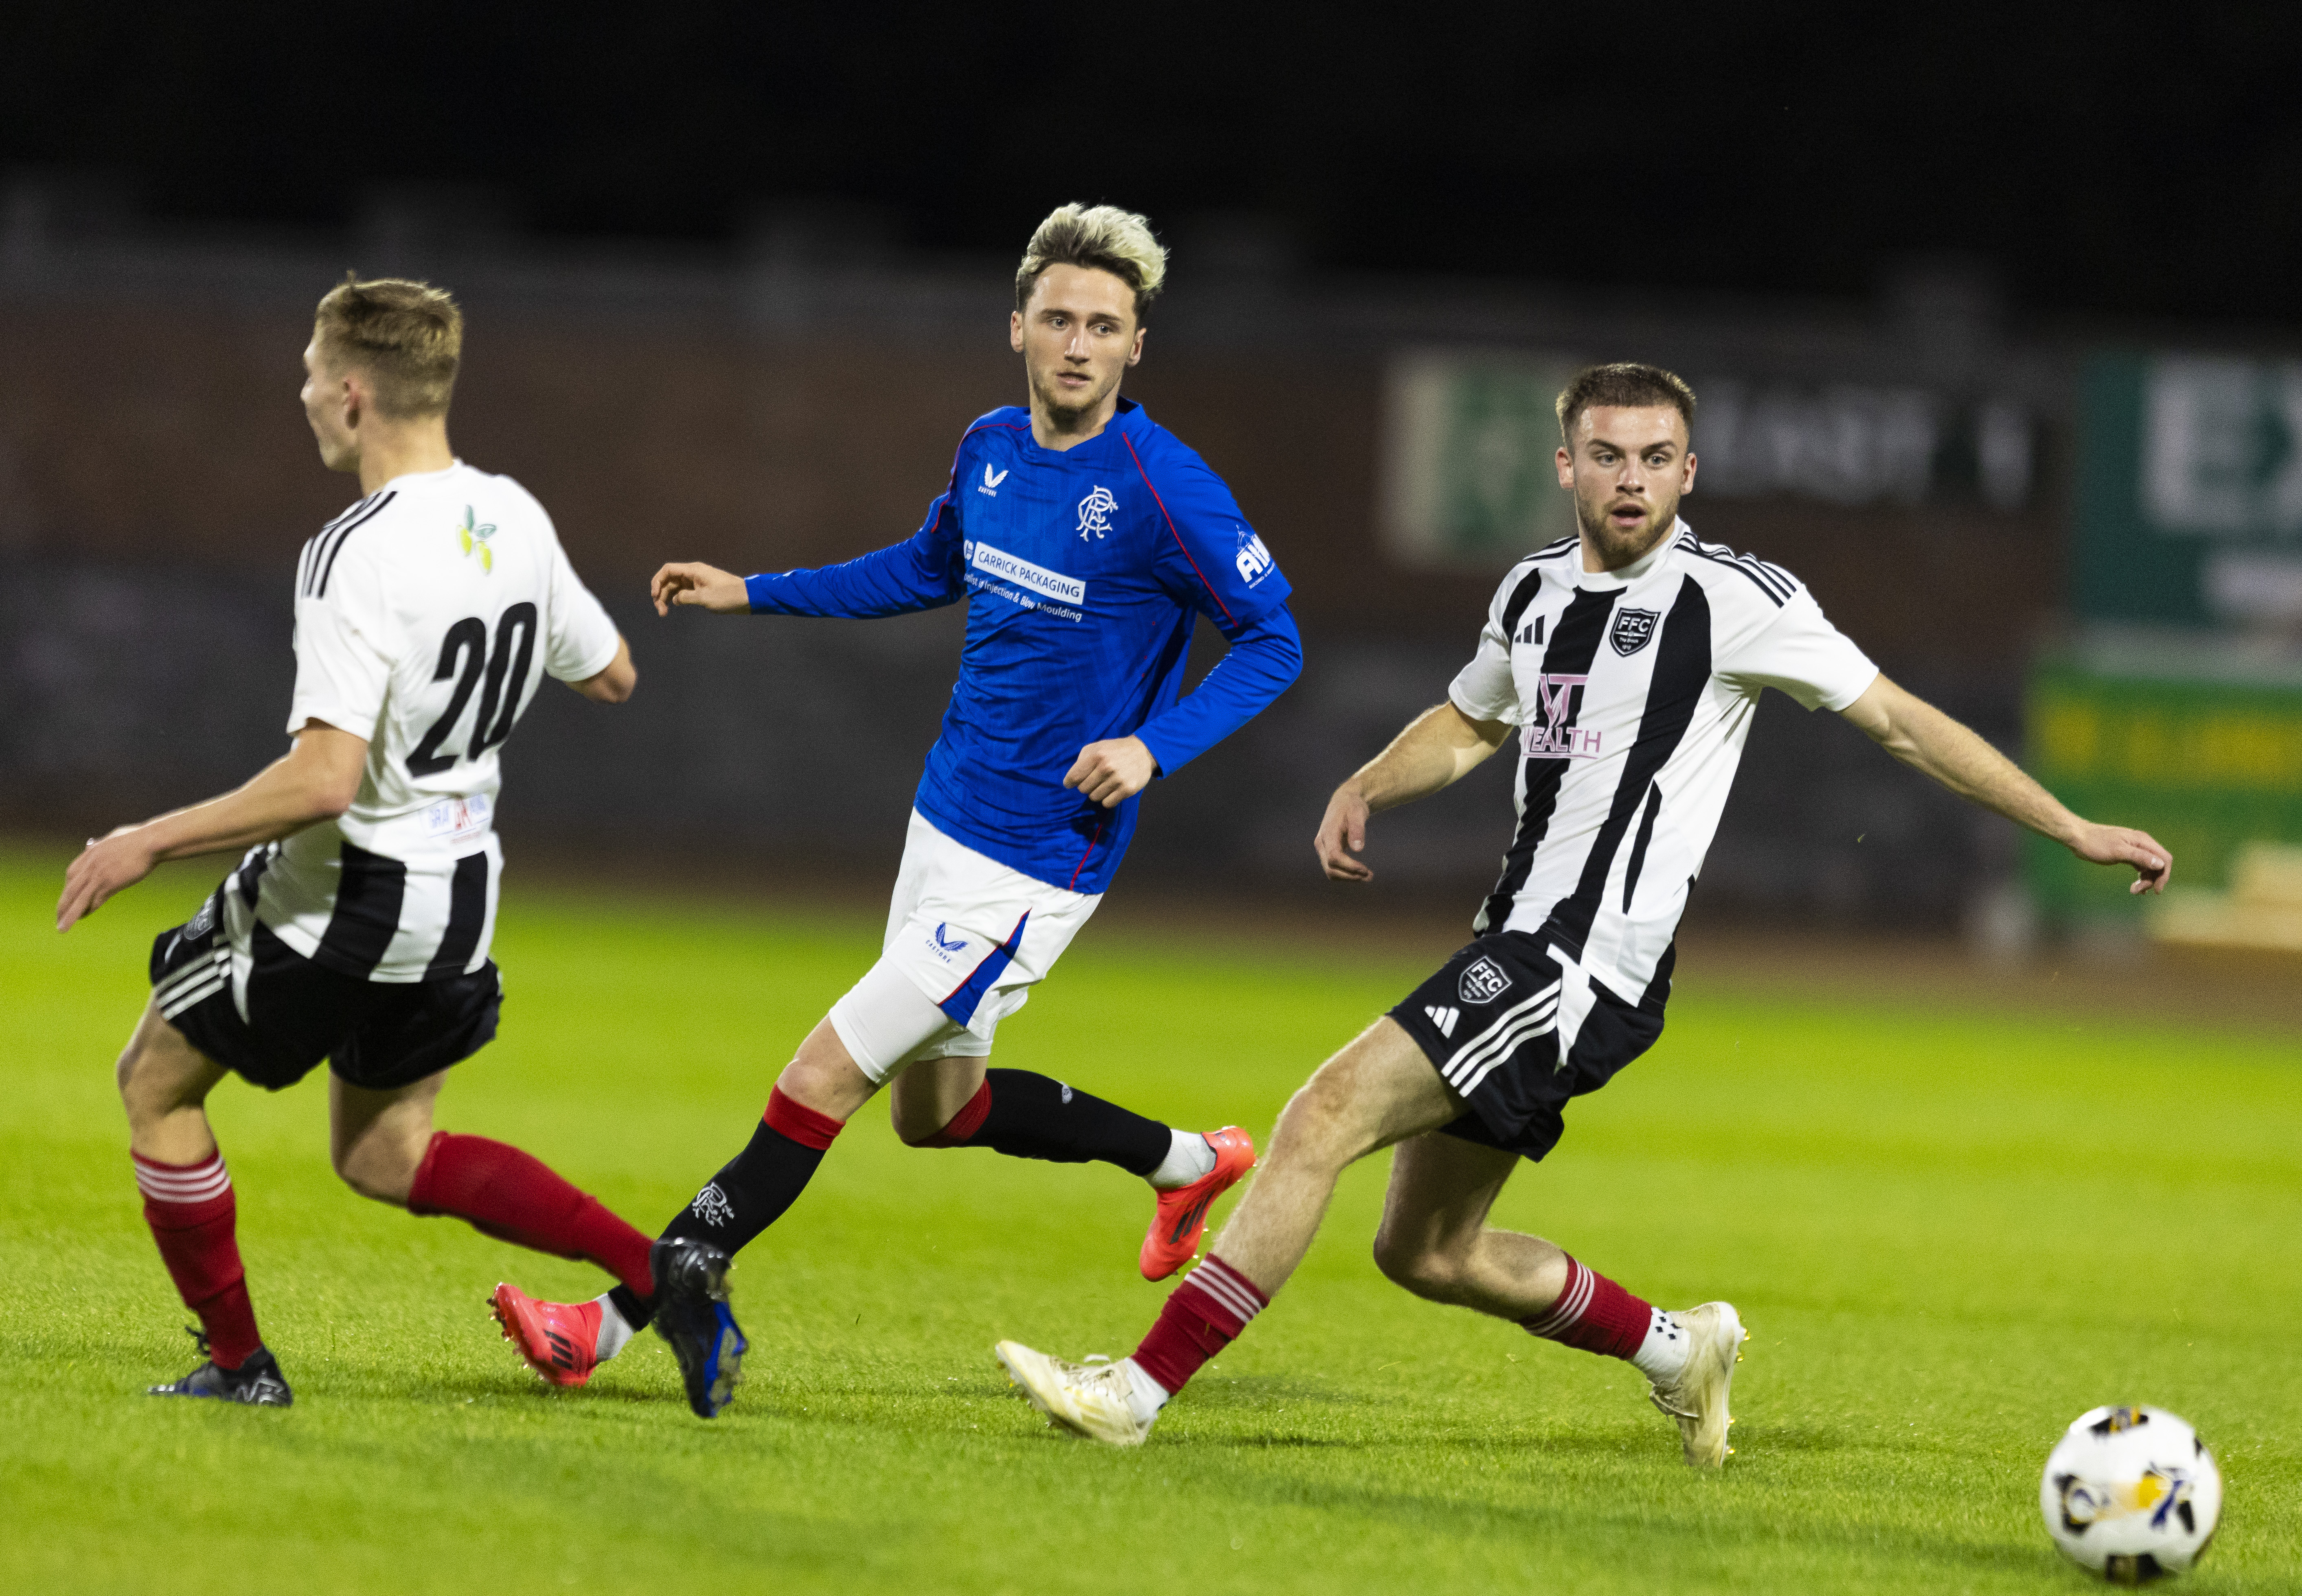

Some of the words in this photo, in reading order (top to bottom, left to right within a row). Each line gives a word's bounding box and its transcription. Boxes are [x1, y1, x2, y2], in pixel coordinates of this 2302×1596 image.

[978, 551, 1017, 576] CARRICK
[1019, 567, 1080, 598] PACKAGING
[984, 580, 1014, 600] Injection
[1013, 591, 1019, 604] &
[1020, 595, 1035, 610] Blow
[1037, 602, 1082, 623] Moulding
[1618, 616, 1651, 632] FFC
[406, 602, 537, 780] 20
[926, 939, 951, 963] CASTORE
[1471, 961, 1503, 992] FFC
